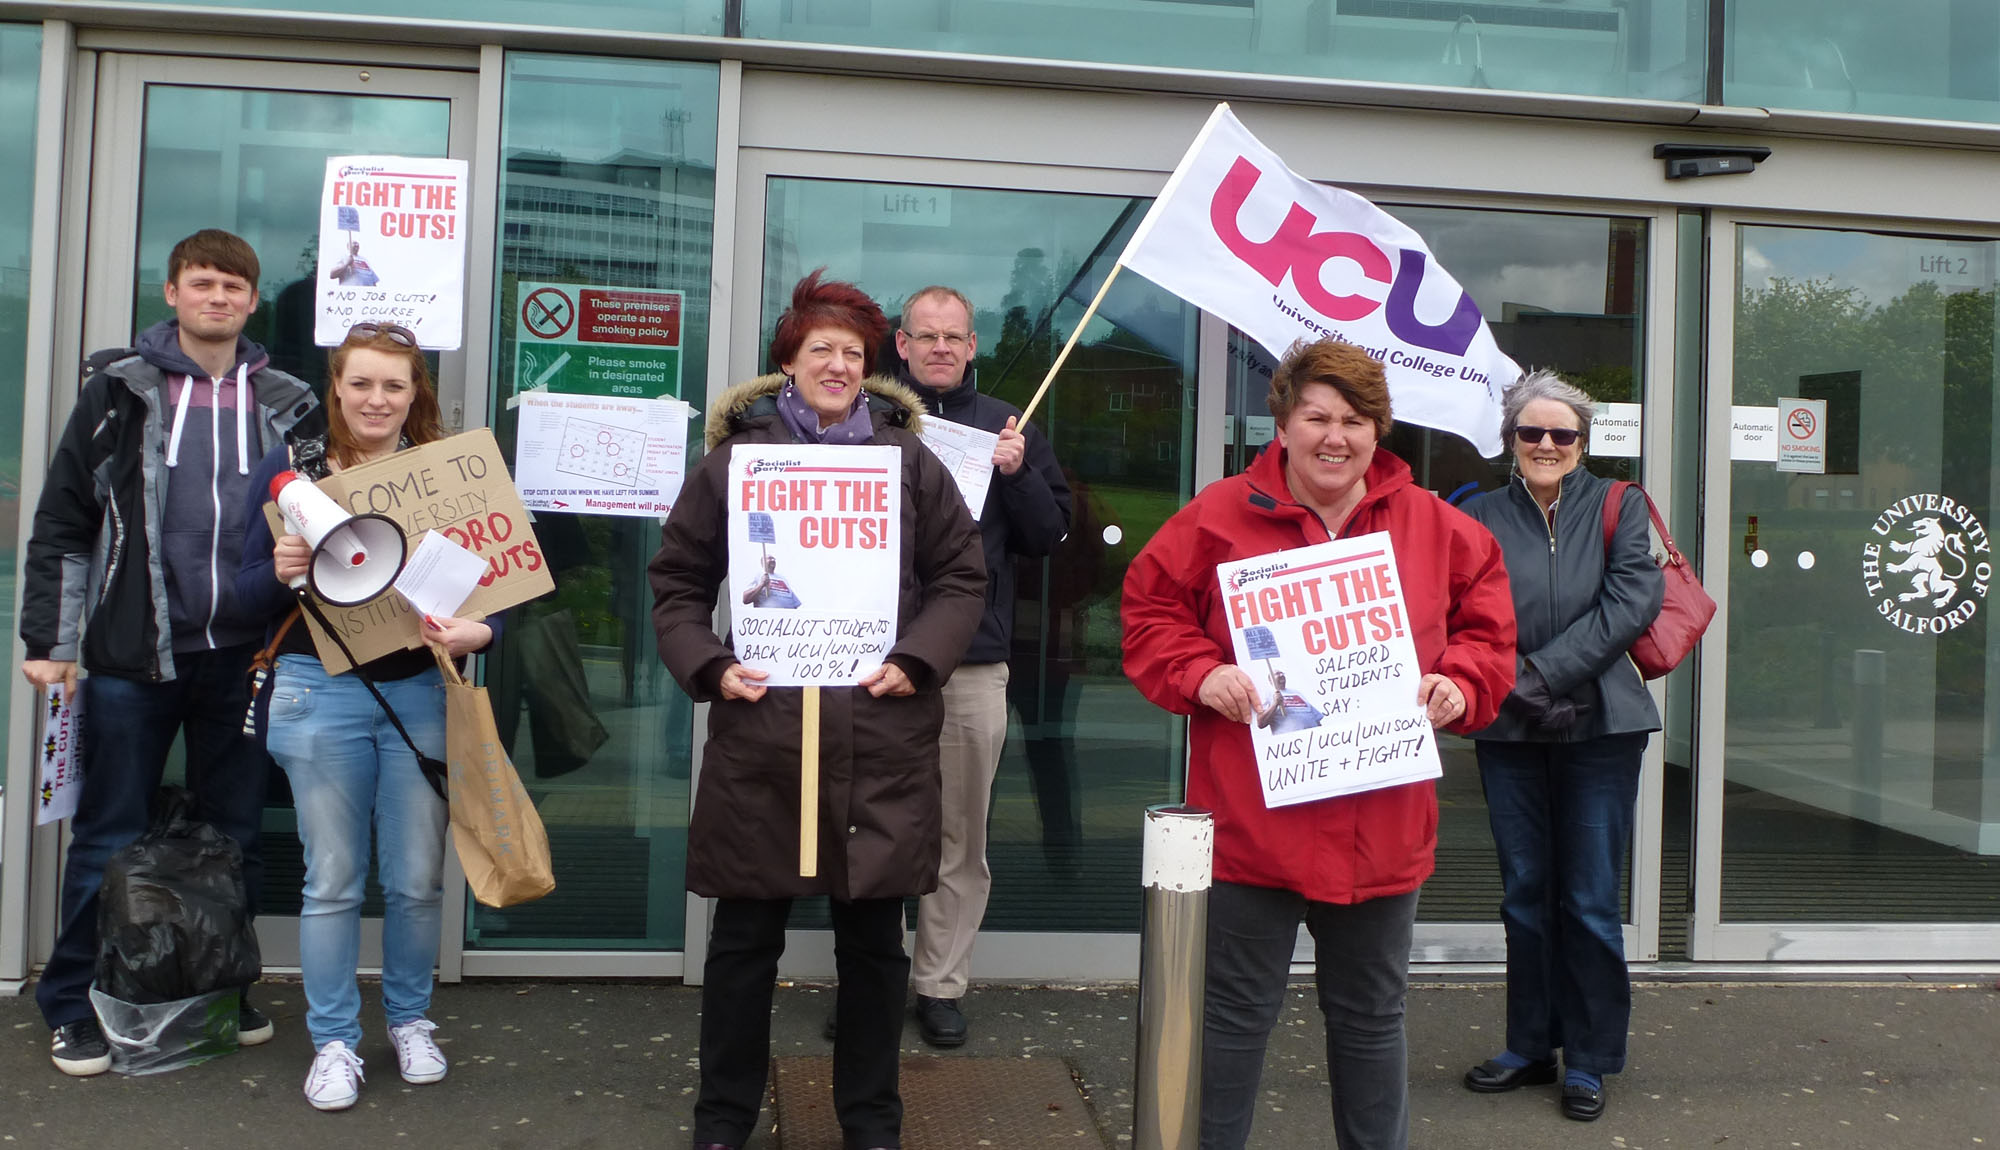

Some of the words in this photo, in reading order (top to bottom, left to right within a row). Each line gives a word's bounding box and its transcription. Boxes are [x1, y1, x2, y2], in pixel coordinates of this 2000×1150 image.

[333, 181, 405, 207] FIGHT
[411, 184, 456, 210] THE
[883, 194, 920, 213] Lift
[928, 197, 937, 214] 1
[380, 211, 455, 240] CUTS!
[1920, 256, 1952, 274] Lift
[1957, 258, 1968, 274] 2
[362, 292, 386, 301] JOB
[394, 293, 436, 304] CUTS!
[590, 298, 621, 309] These
[623, 300, 670, 312] premises
[361, 306, 415, 317] COURSE
[597, 313, 638, 323] operate
[648, 316, 662, 324] no
[592, 324, 636, 337] smoking
[638, 326, 669, 339] policy
[588, 356, 626, 368] Please
[628, 358, 667, 370] smoke
[589, 370, 599, 379] in
[602, 370, 665, 384] designated
[1357, 345, 1388, 361] nd
[1390, 351, 1455, 377] College
[1460, 366, 1494, 403] Uni
[611, 384, 643, 394] areas
[1592, 417, 1639, 428] Automatic
[1733, 423, 1774, 432] Automatic
[1604, 433, 1626, 442] door
[1744, 433, 1762, 441] door
[447, 454, 487, 482] TO
[753, 466, 785, 474] Party
[757, 459, 801, 467] Socialist
[585, 498, 636, 510] Management
[637, 501, 652, 510] will
[741, 480, 827, 512] FIGHT
[834, 480, 888, 512] THE
[800, 516, 888, 549] CUTS!
[1871, 493, 1991, 554] UNIVERSITY
[1238, 572, 1271, 587] Party
[1240, 562, 1289, 578] Socialist
[1863, 543, 1883, 597] THE
[1972, 562, 1992, 598] OF
[1228, 577, 1323, 629] FIGHT
[1329, 563, 1396, 607] THE
[1877, 599, 1977, 634] SALFORD
[739, 617, 825, 638] SOCIALIST
[823, 618, 890, 638] STUDENTS
[1301, 603, 1405, 656] CUTS!
[743, 644, 780, 663] BACK
[1316, 644, 1390, 675] SALFORD
[1316, 663, 1403, 696] STUDENTS
[57, 708, 71, 752] CUTS
[1268, 758, 1329, 792] UNITE
[1339, 757, 1351, 771] +
[1356, 734, 1425, 771] FIGHT!
[55, 757, 66, 790] THE
[481, 743, 513, 857] PRIMARK
